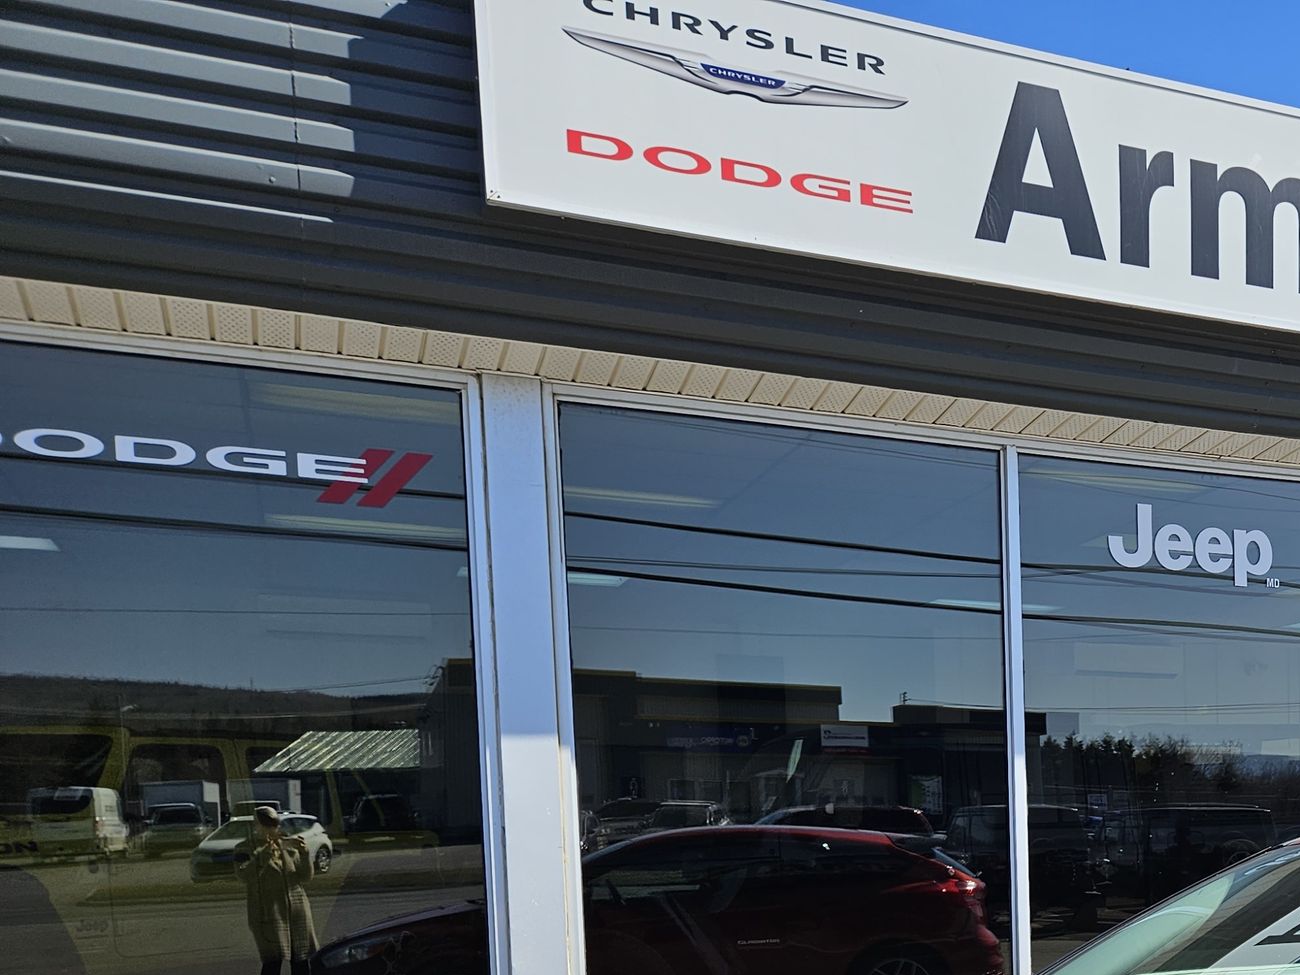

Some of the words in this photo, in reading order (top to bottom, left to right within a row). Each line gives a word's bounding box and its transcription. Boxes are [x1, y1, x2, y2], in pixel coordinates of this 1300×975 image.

[582, 0, 886, 75] CHRYSLER
[709, 67, 776, 86] CHRYSLER
[566, 129, 914, 214] DODGE
[0, 428, 368, 484] ODGE
[1107, 503, 1273, 587] Jeep
[1266, 577, 1280, 589] MD
